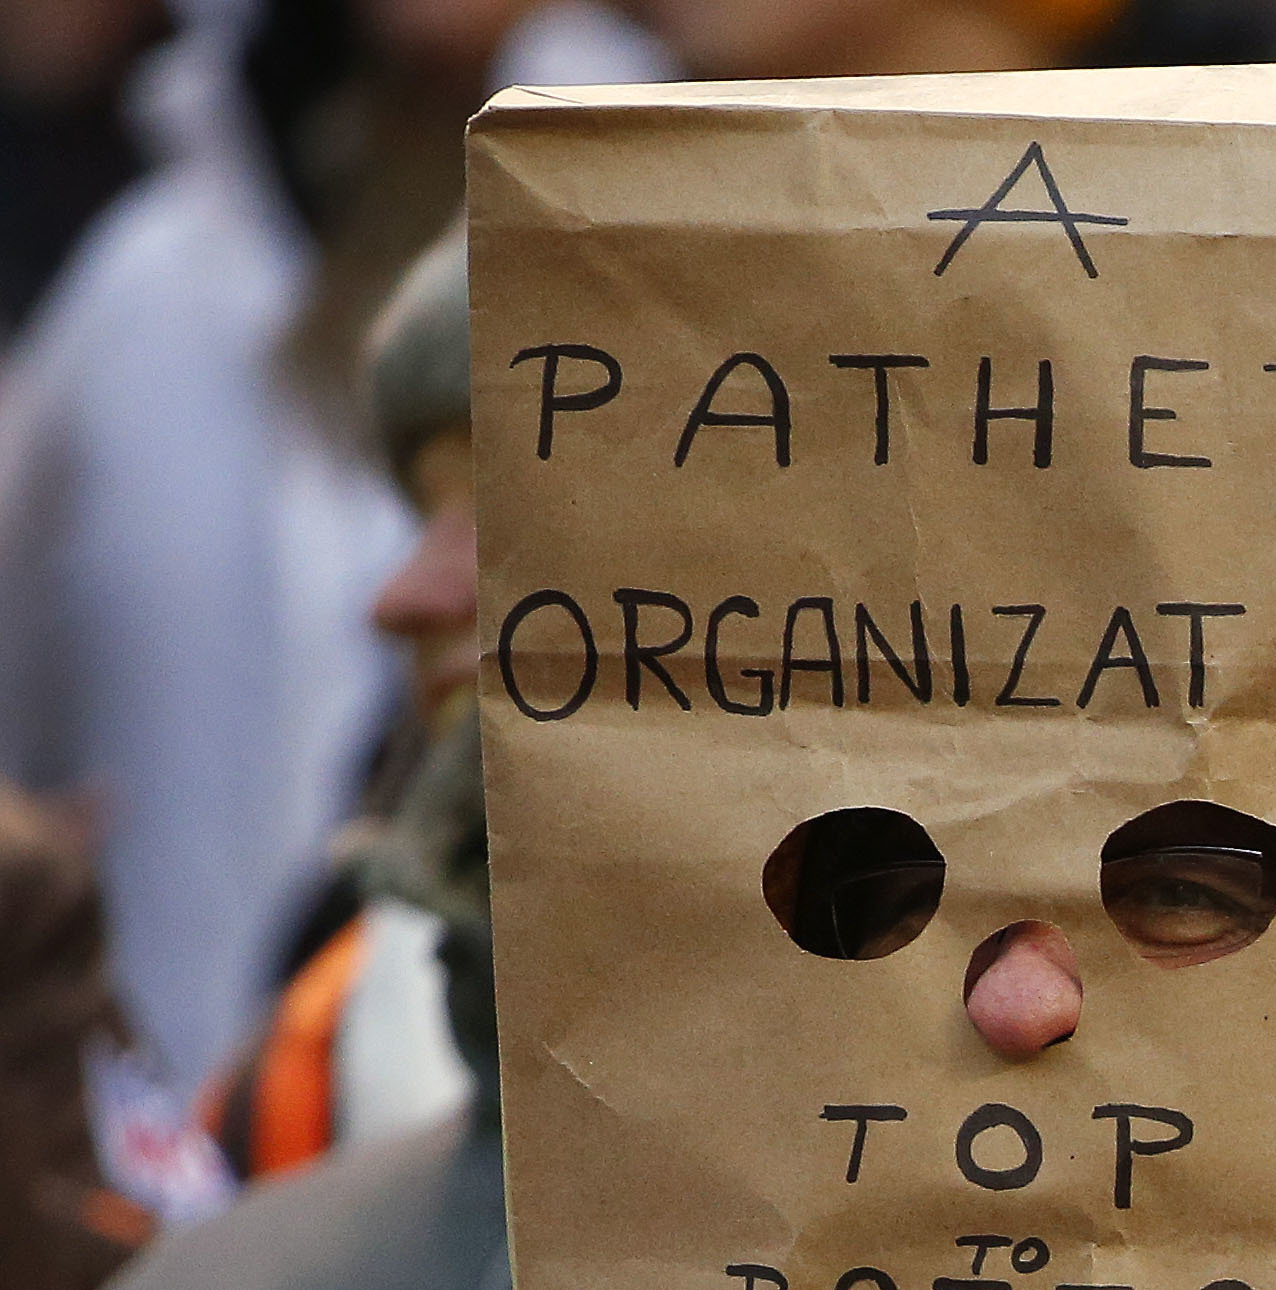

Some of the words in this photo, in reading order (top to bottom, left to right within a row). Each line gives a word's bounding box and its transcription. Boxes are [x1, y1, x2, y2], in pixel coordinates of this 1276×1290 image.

[927, 142, 1130, 280] A
[818, 1103, 1195, 1211] TOP
[954, 1234, 1051, 1276] TO
